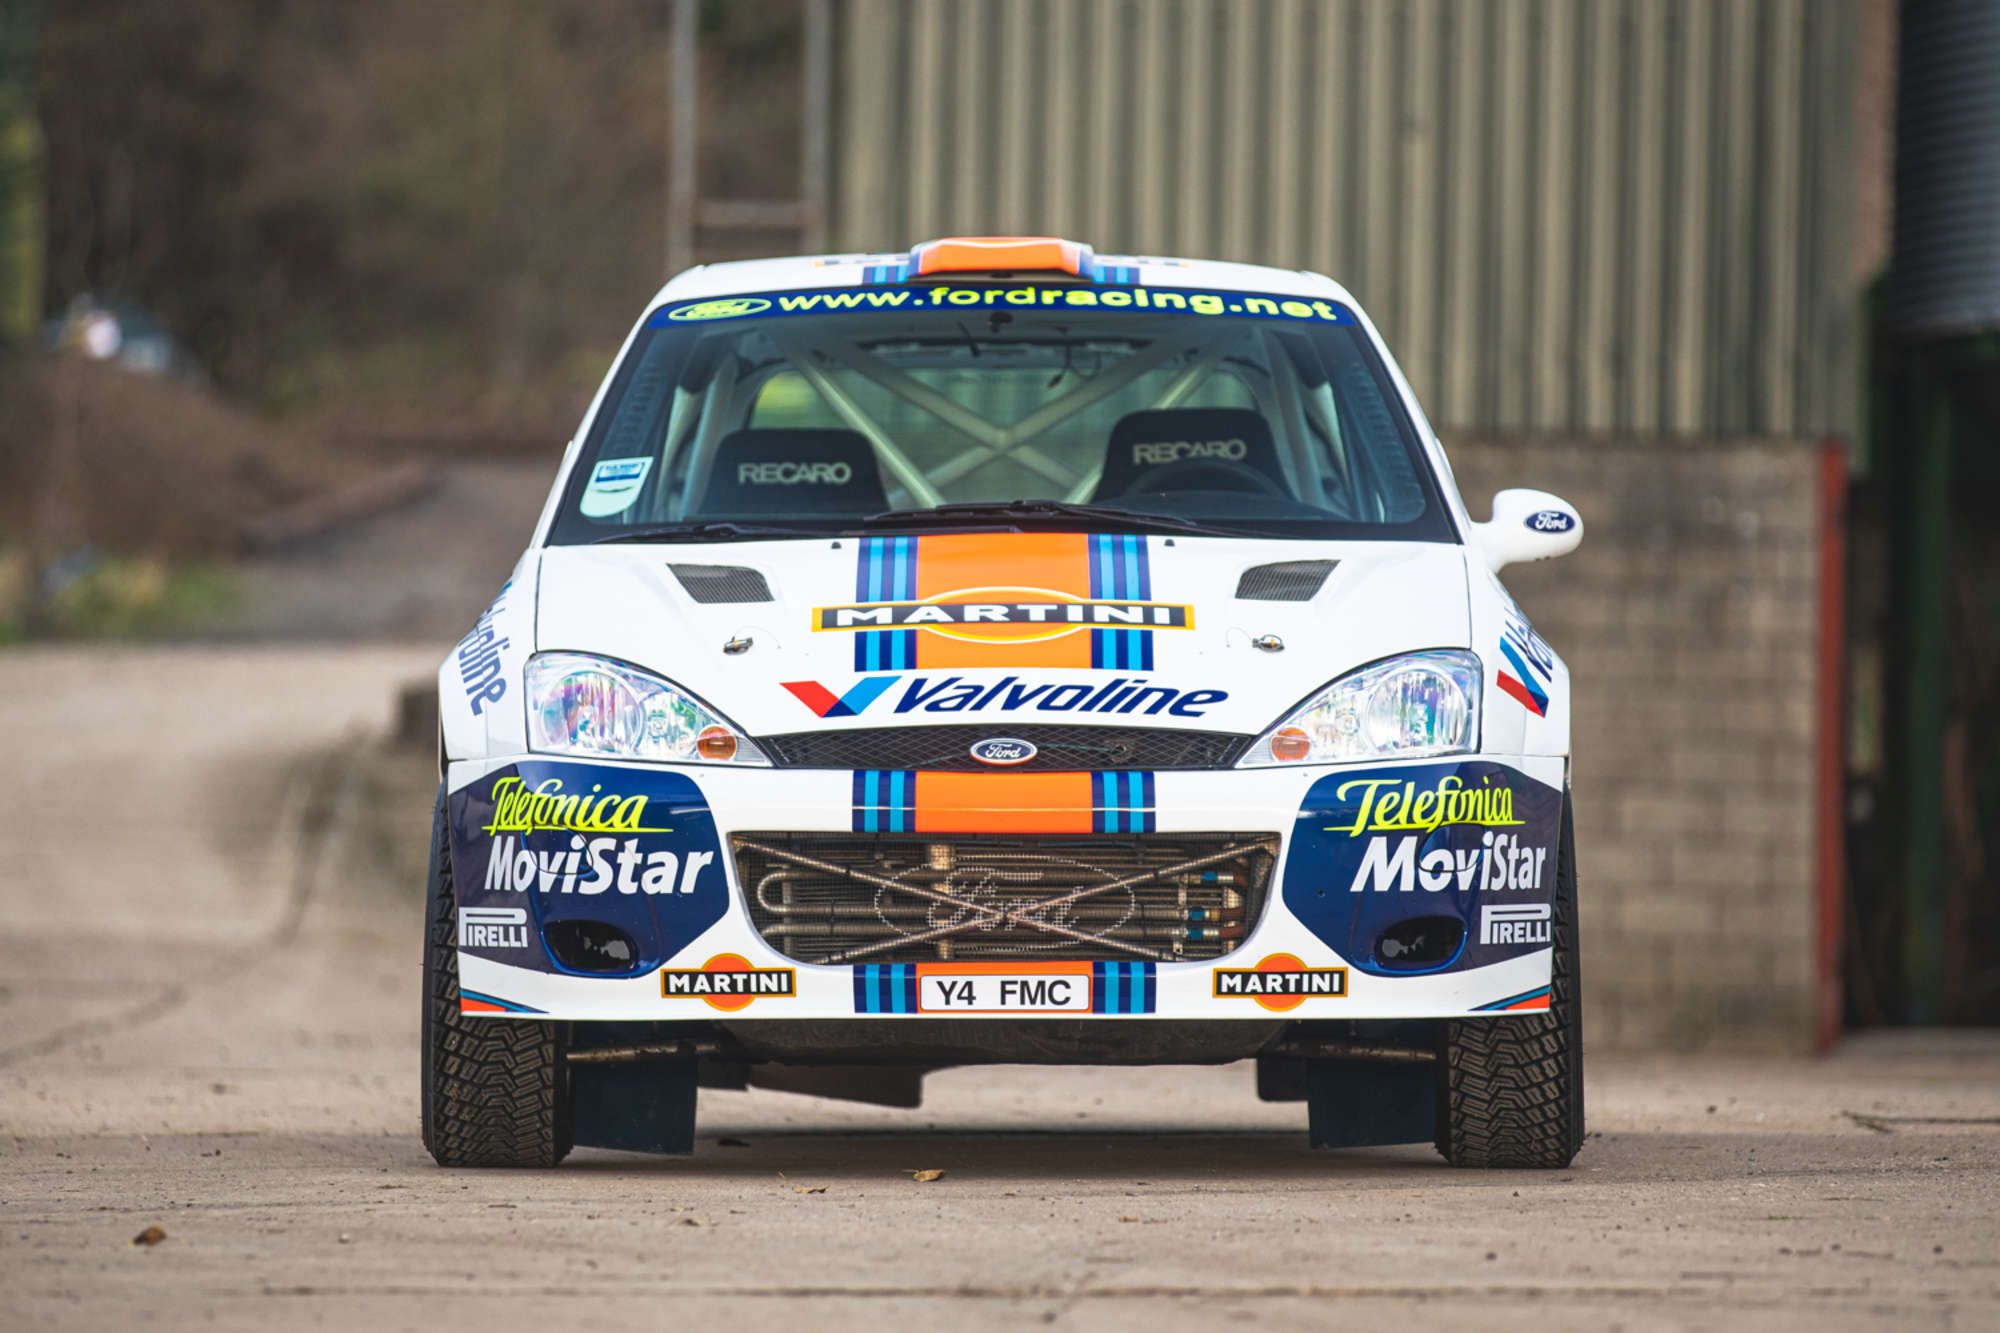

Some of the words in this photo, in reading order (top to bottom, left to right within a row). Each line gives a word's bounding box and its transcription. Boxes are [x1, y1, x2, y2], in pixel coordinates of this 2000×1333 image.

[779, 287, 1337, 321] www.fordracing.net
[1133, 439, 1247, 465] RECARO
[739, 463, 851, 485] RECARO
[1535, 511, 1568, 530] Ford
[836, 604, 1171, 626] MARTINI
[893, 676, 1230, 718] Valvoline
[985, 743, 1022, 759] Ford
[484, 834, 714, 895] MoviStar
[1349, 830, 1547, 892] MoviStar
[458, 906, 529, 948] PIRELLI
[1479, 903, 1551, 945] PIRELLI
[668, 973, 788, 994] MARTINI
[936, 980, 977, 1006] Y4
[1000, 979, 1072, 1006] FMC
[1220, 973, 1341, 994] MARTINI
